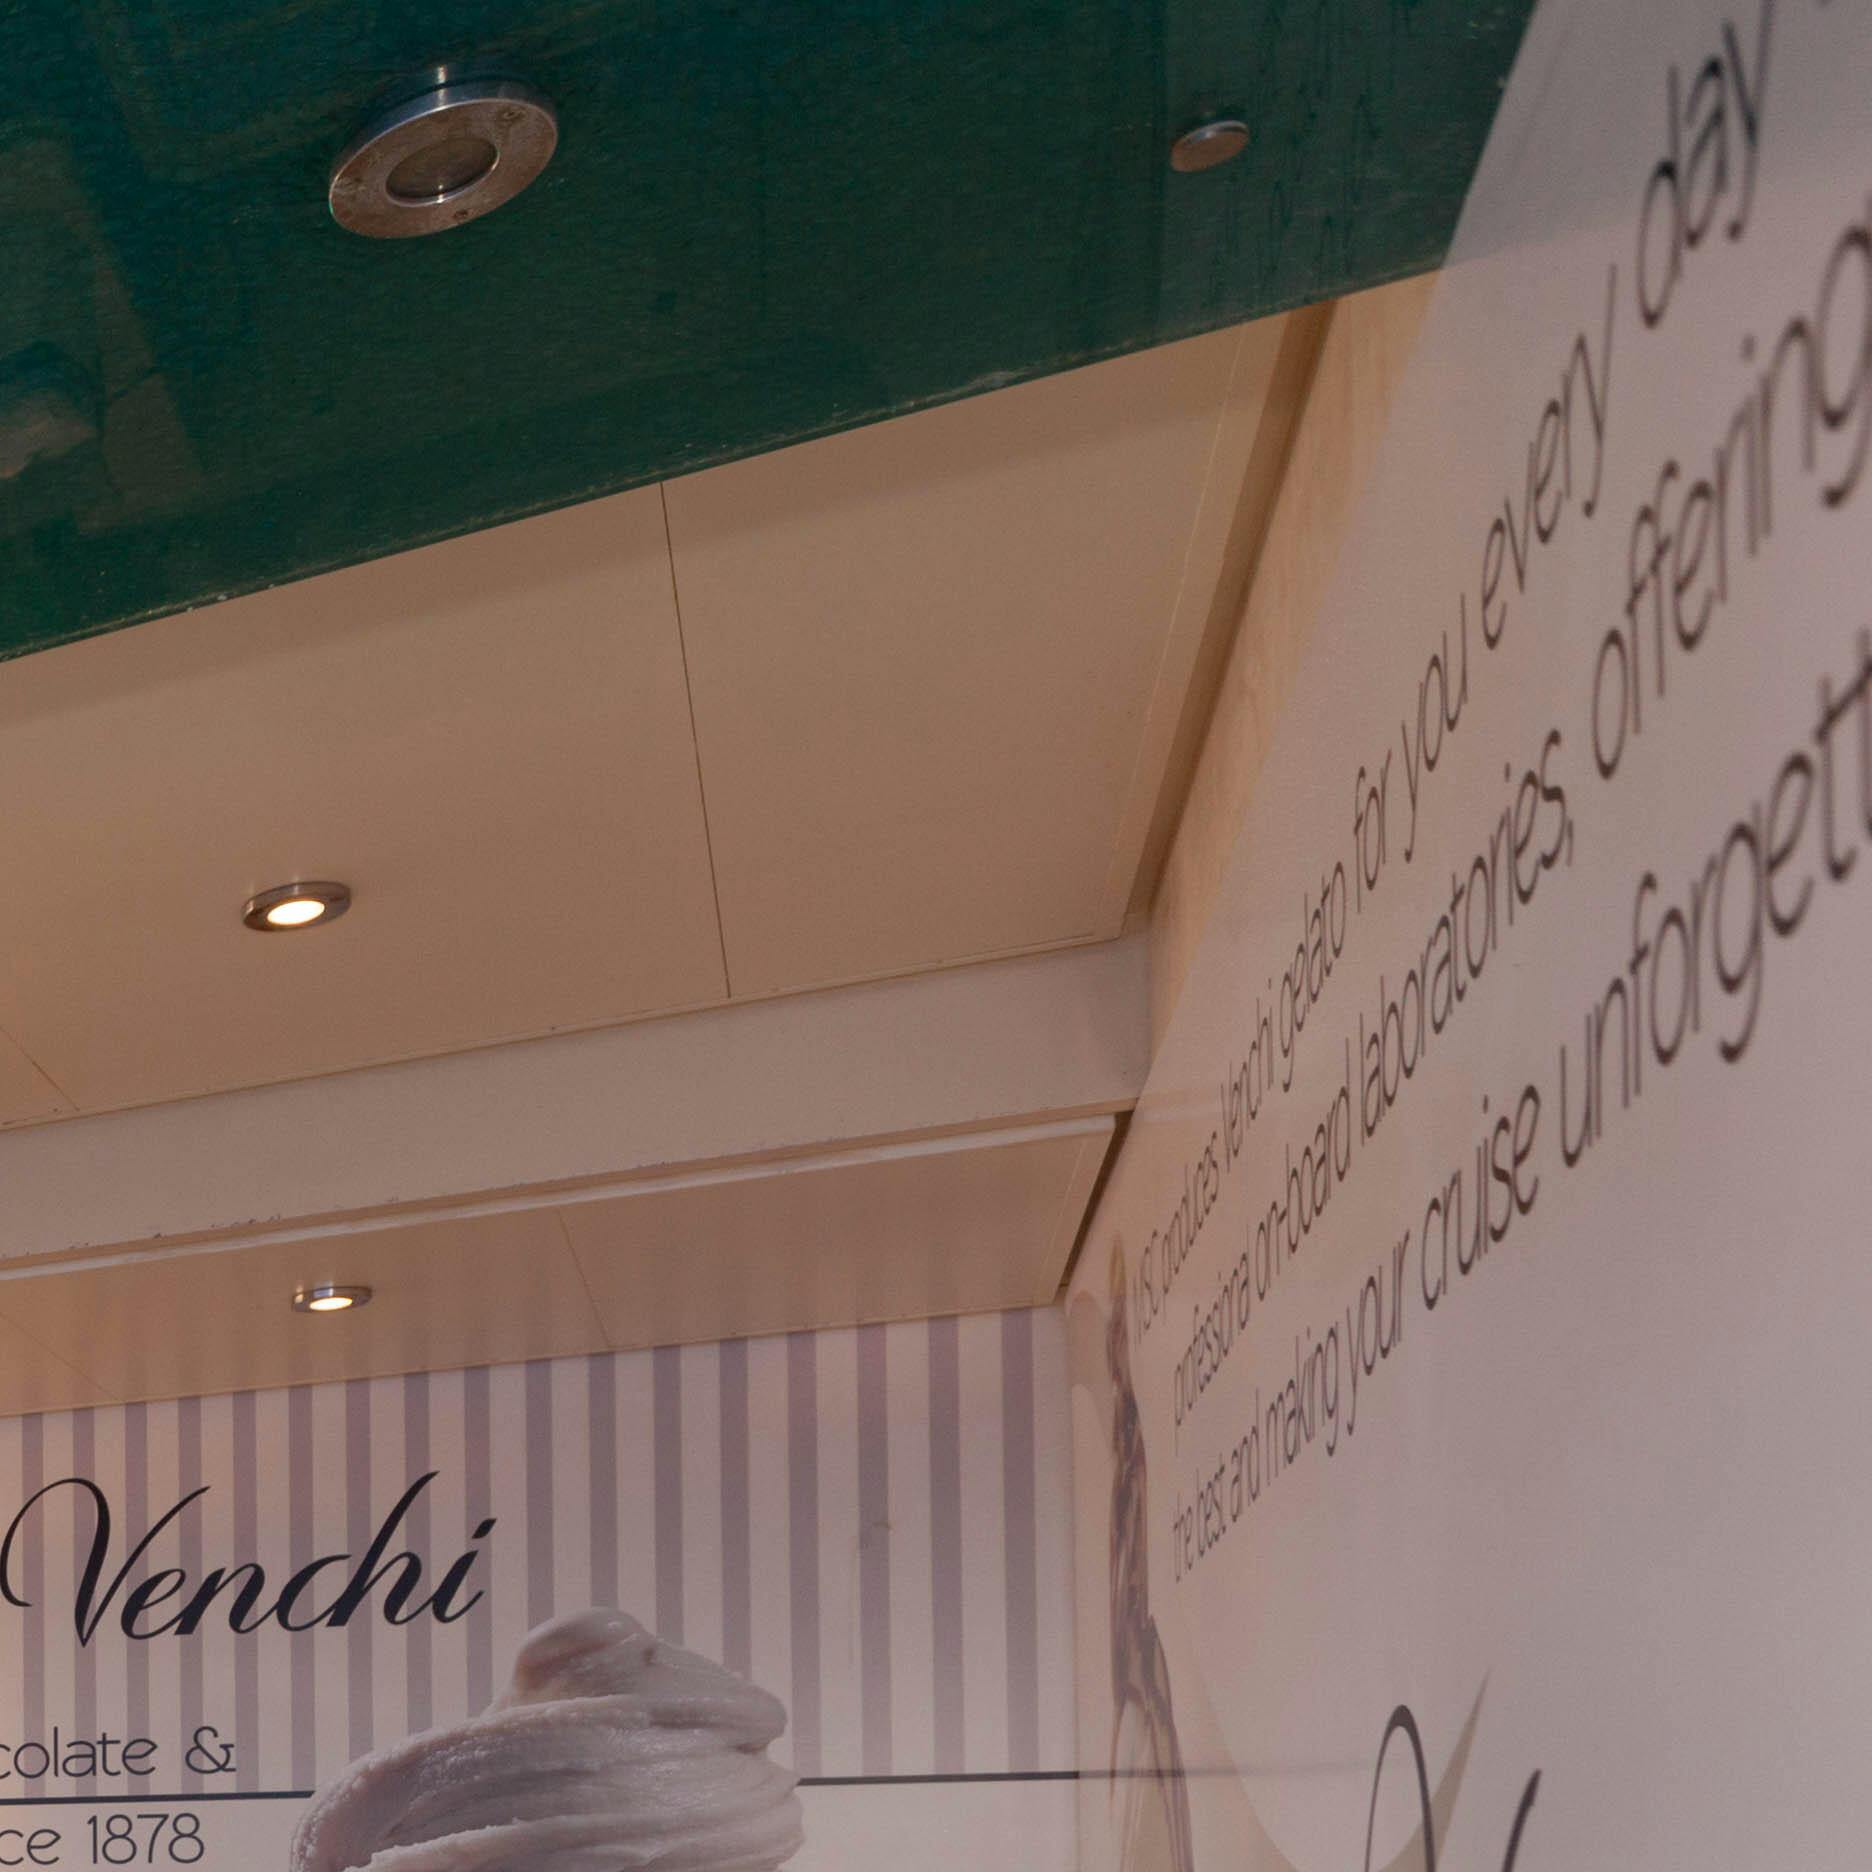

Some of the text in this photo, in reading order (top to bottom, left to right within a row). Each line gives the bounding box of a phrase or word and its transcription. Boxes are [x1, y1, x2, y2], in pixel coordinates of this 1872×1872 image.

[1278, 860, 1347, 1093] gelato
[1353, 747, 1392, 914] for
[1400, 592, 1467, 864] you
[1479, 262, 1617, 649] every
[1637, 0, 1776, 330] day
[1256, 1035, 1351, 1301] on-board
[1360, 729, 1574, 1148] laboratories,
[1231, 1386, 1261, 1523] and
[1266, 1319, 1340, 1488] making
[1346, 1226, 1411, 1437] your
[1420, 1082, 1541, 1312] cruise
[86, 1812, 206, 1866] 1878
[183, 1725, 238, 1776] &
